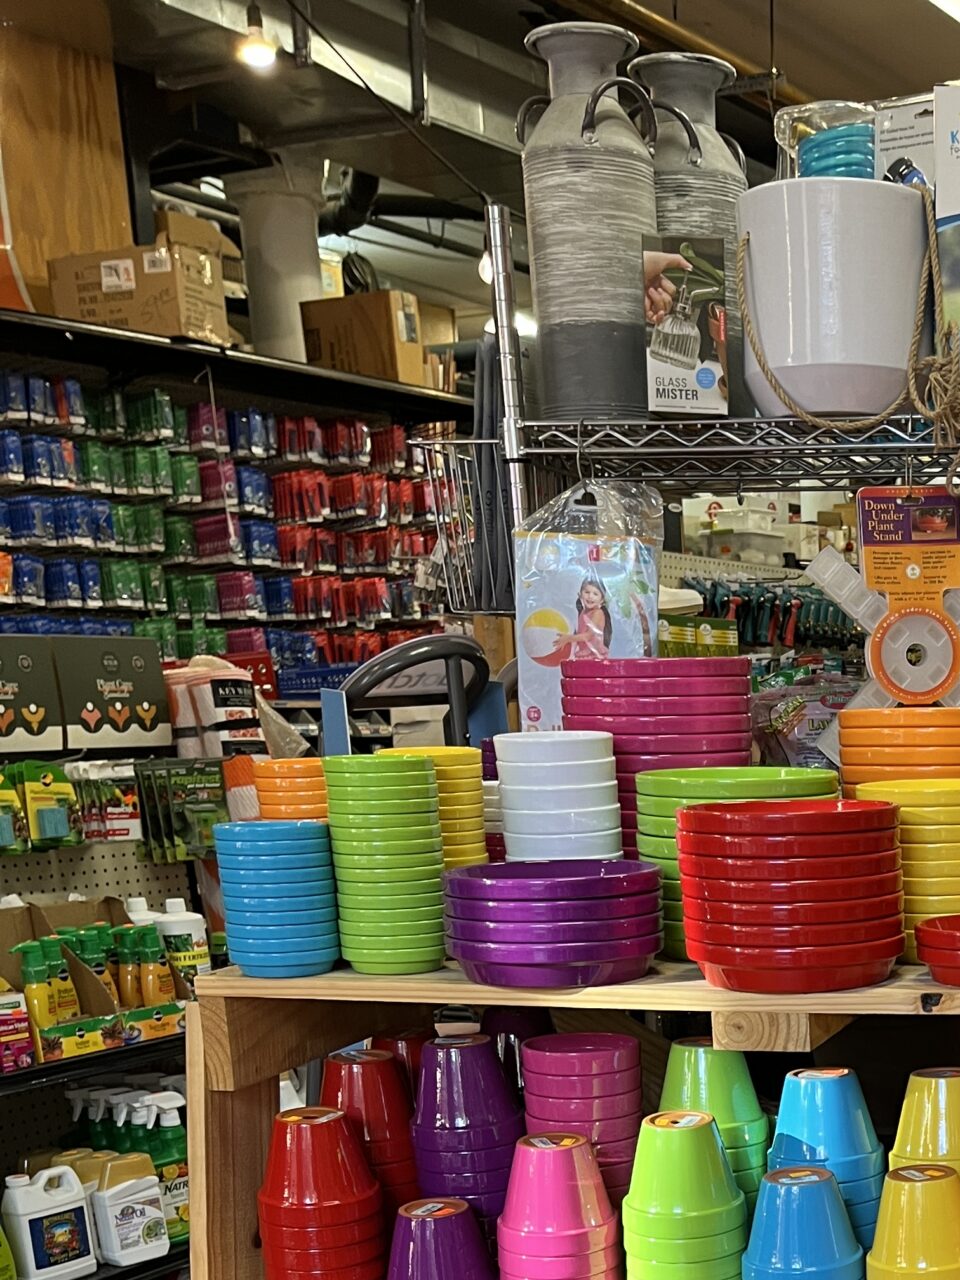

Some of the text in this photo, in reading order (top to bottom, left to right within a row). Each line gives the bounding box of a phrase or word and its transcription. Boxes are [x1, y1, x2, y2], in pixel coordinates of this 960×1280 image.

[655, 376, 688, 389] GLASS
[655, 388, 699, 401] MISTER
[864, 500, 896, 511] Down
[872, 511, 905, 521] Under
[867, 520, 895, 532] Plant
[873, 530, 903, 541] Stand
[163, 1179, 188, 1196] NATR
